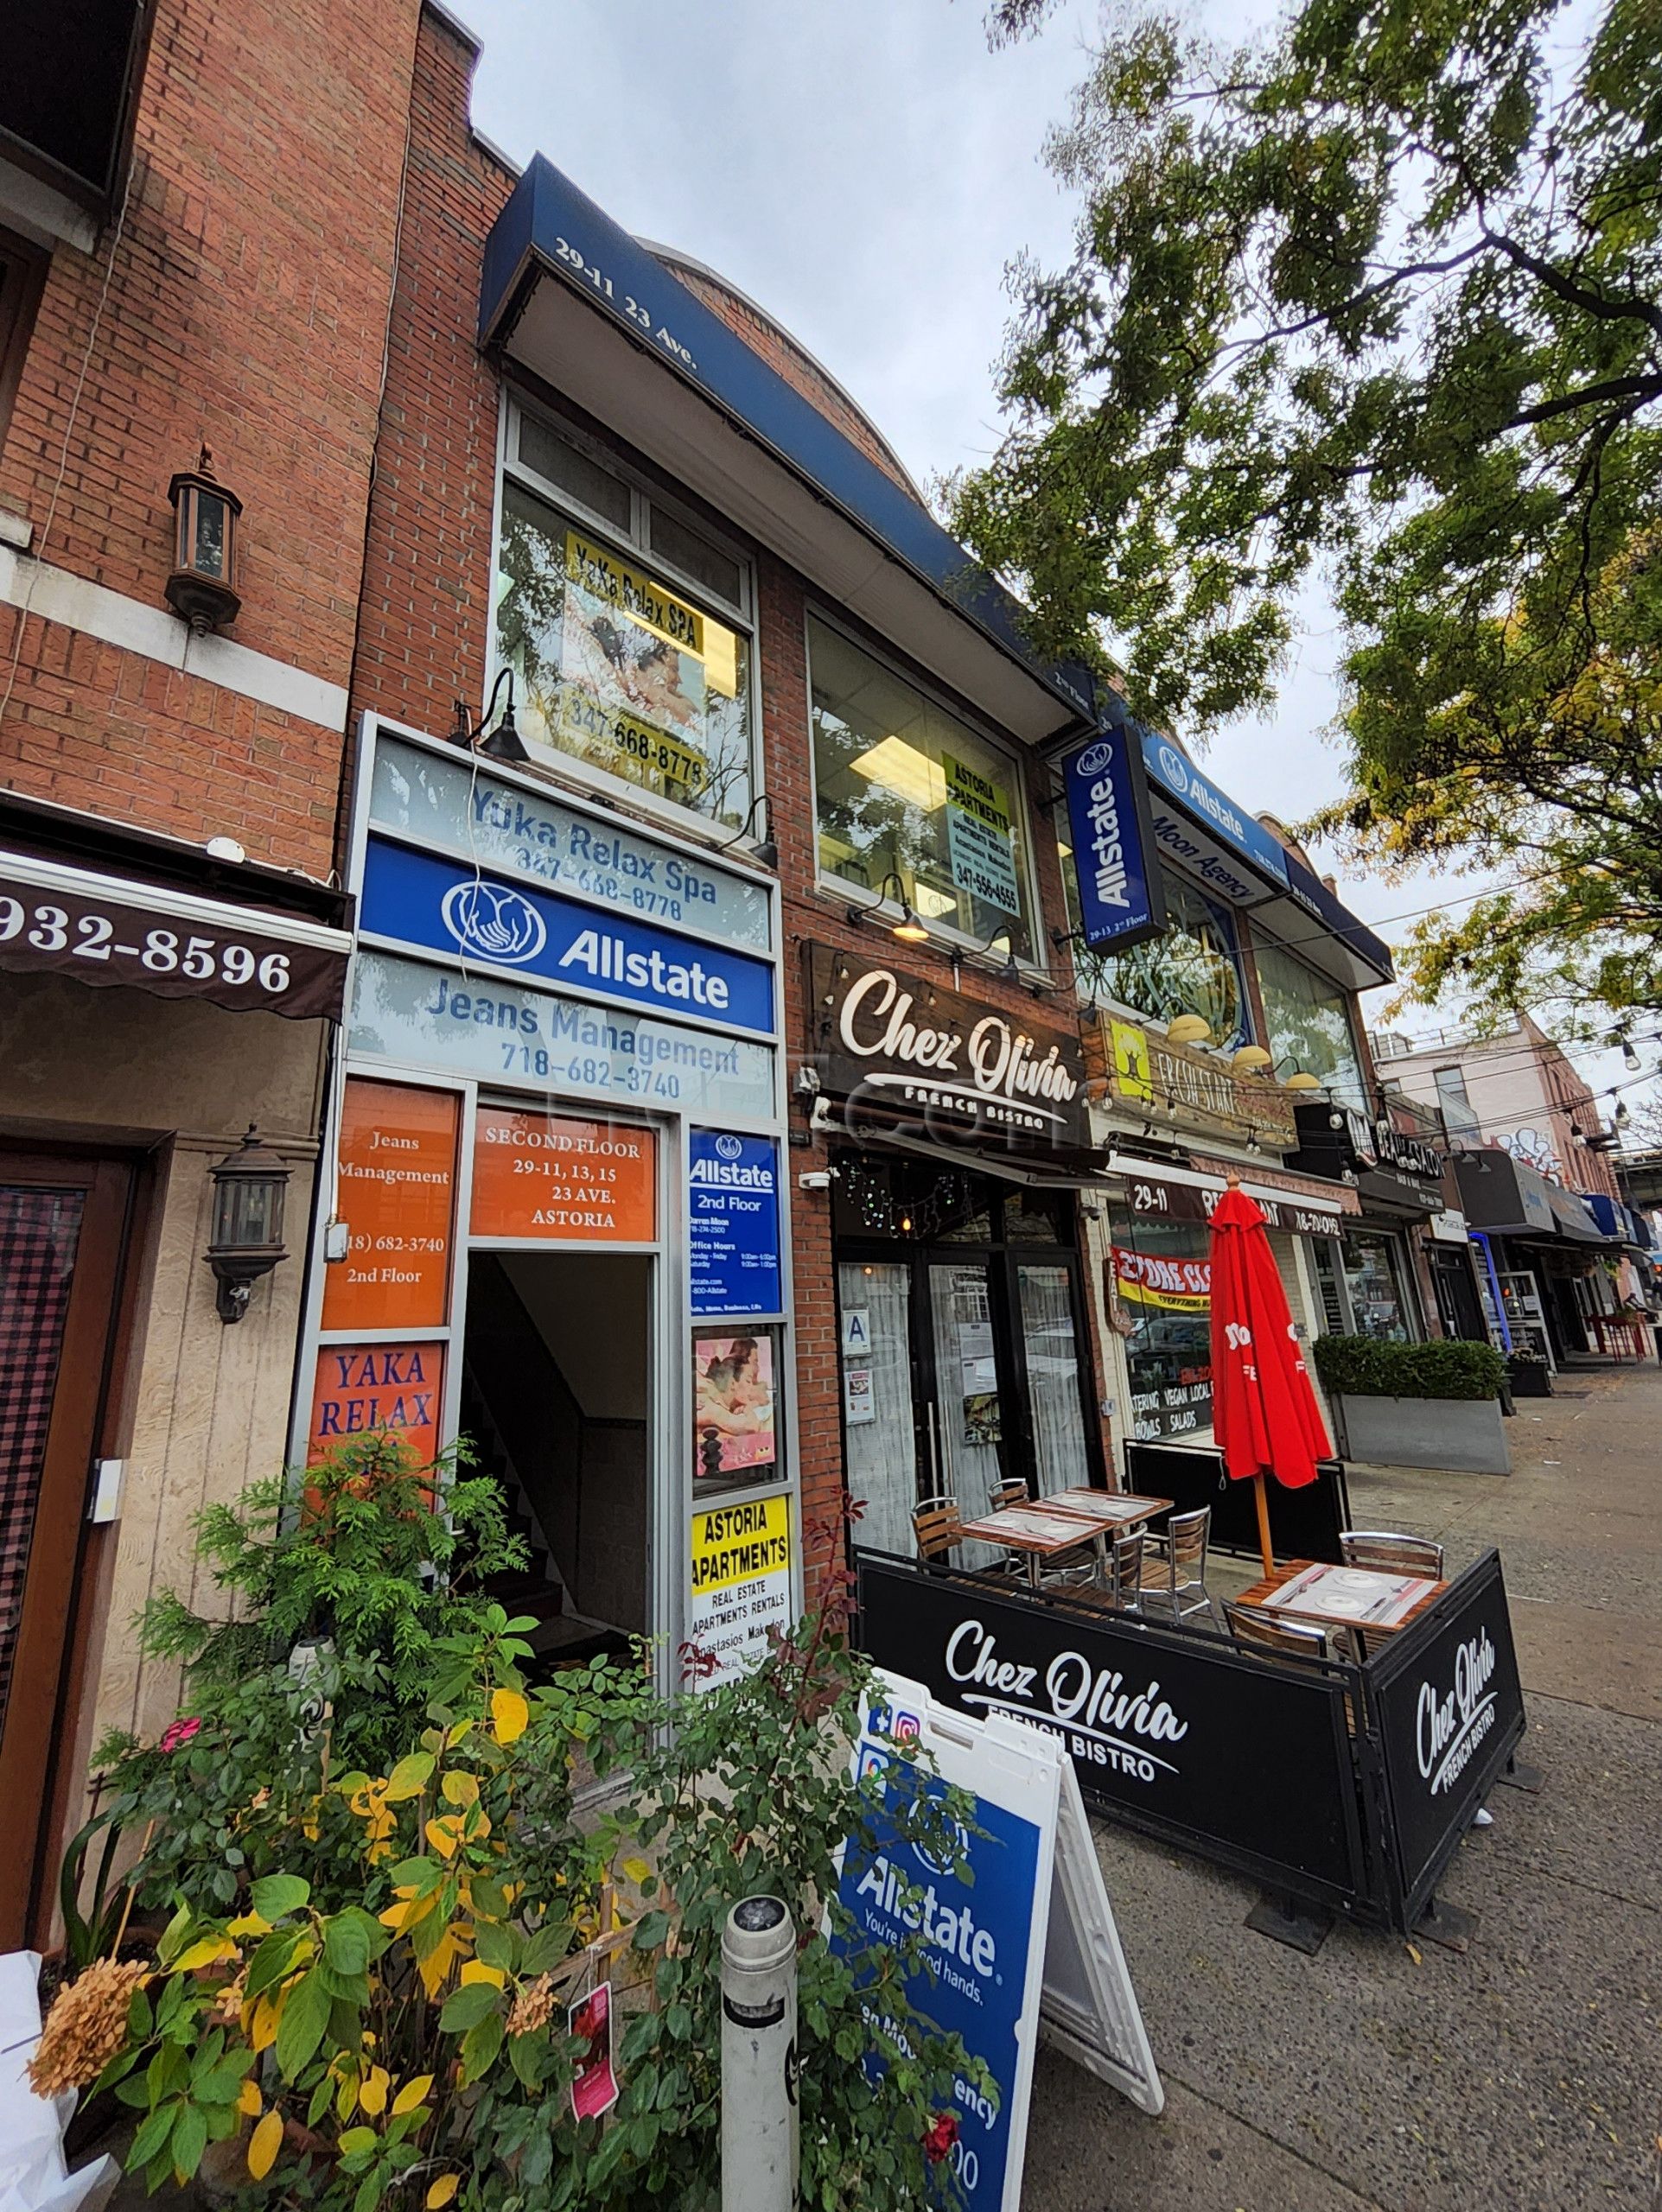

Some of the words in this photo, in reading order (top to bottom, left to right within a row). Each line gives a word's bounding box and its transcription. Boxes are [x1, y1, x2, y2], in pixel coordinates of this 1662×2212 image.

[556, 237, 614, 300] 29-11
[625, 296, 651, 328] 23
[655, 327, 697, 370] Ave.
[668, 604, 697, 649] SPA
[570, 698, 702, 785] 347-668-8778
[955, 763, 996, 804] ASTORIA
[1190, 779, 1245, 842] Allstate
[570, 823, 656, 883] Relax
[665, 861, 716, 905] Spa
[1086, 777, 1130, 908] Allstate
[1153, 816, 1200, 858] Moon
[1194, 855, 1254, 899] Agency
[557, 930, 730, 1010] Allstate
[429, 977, 539, 1034] Jeans
[551, 1005, 740, 1076] Management
[839, 969, 962, 1071] Chez
[968, 1016, 1078, 1103] Olivia
[500, 1042, 680, 1100] 718-682-3740
[904, 1086, 978, 1115] FRENCH
[985, 1105, 1044, 1130] BISTRO
[370, 1131, 420, 1151] Jeans
[485, 1127, 573, 1152] SECOND
[576, 1139, 641, 1159] FLOOR
[339, 1162, 449, 1185] Management
[513, 1160, 567, 1180] 29-11,
[571, 1166, 594, 1182] 13,
[599, 1169, 617, 1183] 15
[689, 1159, 774, 1187] Allstate
[552, 1186, 573, 1201] 23
[575, 1189, 617, 1205] AVE.
[697, 1194, 726, 1211] 2nd
[729, 1196, 762, 1212] Floor
[1134, 1184, 1168, 1211] 29-11
[532, 1209, 616, 1229] ASTORIA
[375, 1236, 445, 1252] 682-3740
[714, 1242, 735, 1251] Hours
[347, 1268, 378, 1283] 2nd
[380, 1268, 423, 1284] Floor
[1109, 1260, 1119, 1313] EAT
[849, 1315, 865, 1343] A
[336, 1352, 427, 1389] YAKA
[318, 1394, 433, 1437] RELAX
[1163, 1386, 1188, 1407] VEGAN
[1190, 1382, 1211, 1402] LOCAL
[1169, 1410, 1197, 1433] SALADS
[704, 1504, 767, 1545] ASTORIA
[691, 1535, 786, 1587] APARTMENTS
[692, 1606, 748, 1636] APARTMENTS
[751, 1592, 785, 1616] RENTALS
[712, 1594, 733, 1609] REAL
[737, 1580, 766, 1600] ESTATE
[697, 1632, 743, 1657] nastasios
[946, 1620, 1037, 1698] Chez
[1046, 1651, 1188, 1742] Olivia
[1417, 1681, 1457, 1779] Chez
[1455, 1625, 1495, 1724] Olivia
[1072, 1738, 1156, 1782] BISTRO
[1442, 1739, 1472, 1794] FRENCH
[1470, 1702, 1495, 1750] BISTRO
[865, 1908, 897, 1946] You're
[943, 1961, 984, 2006] hands.
